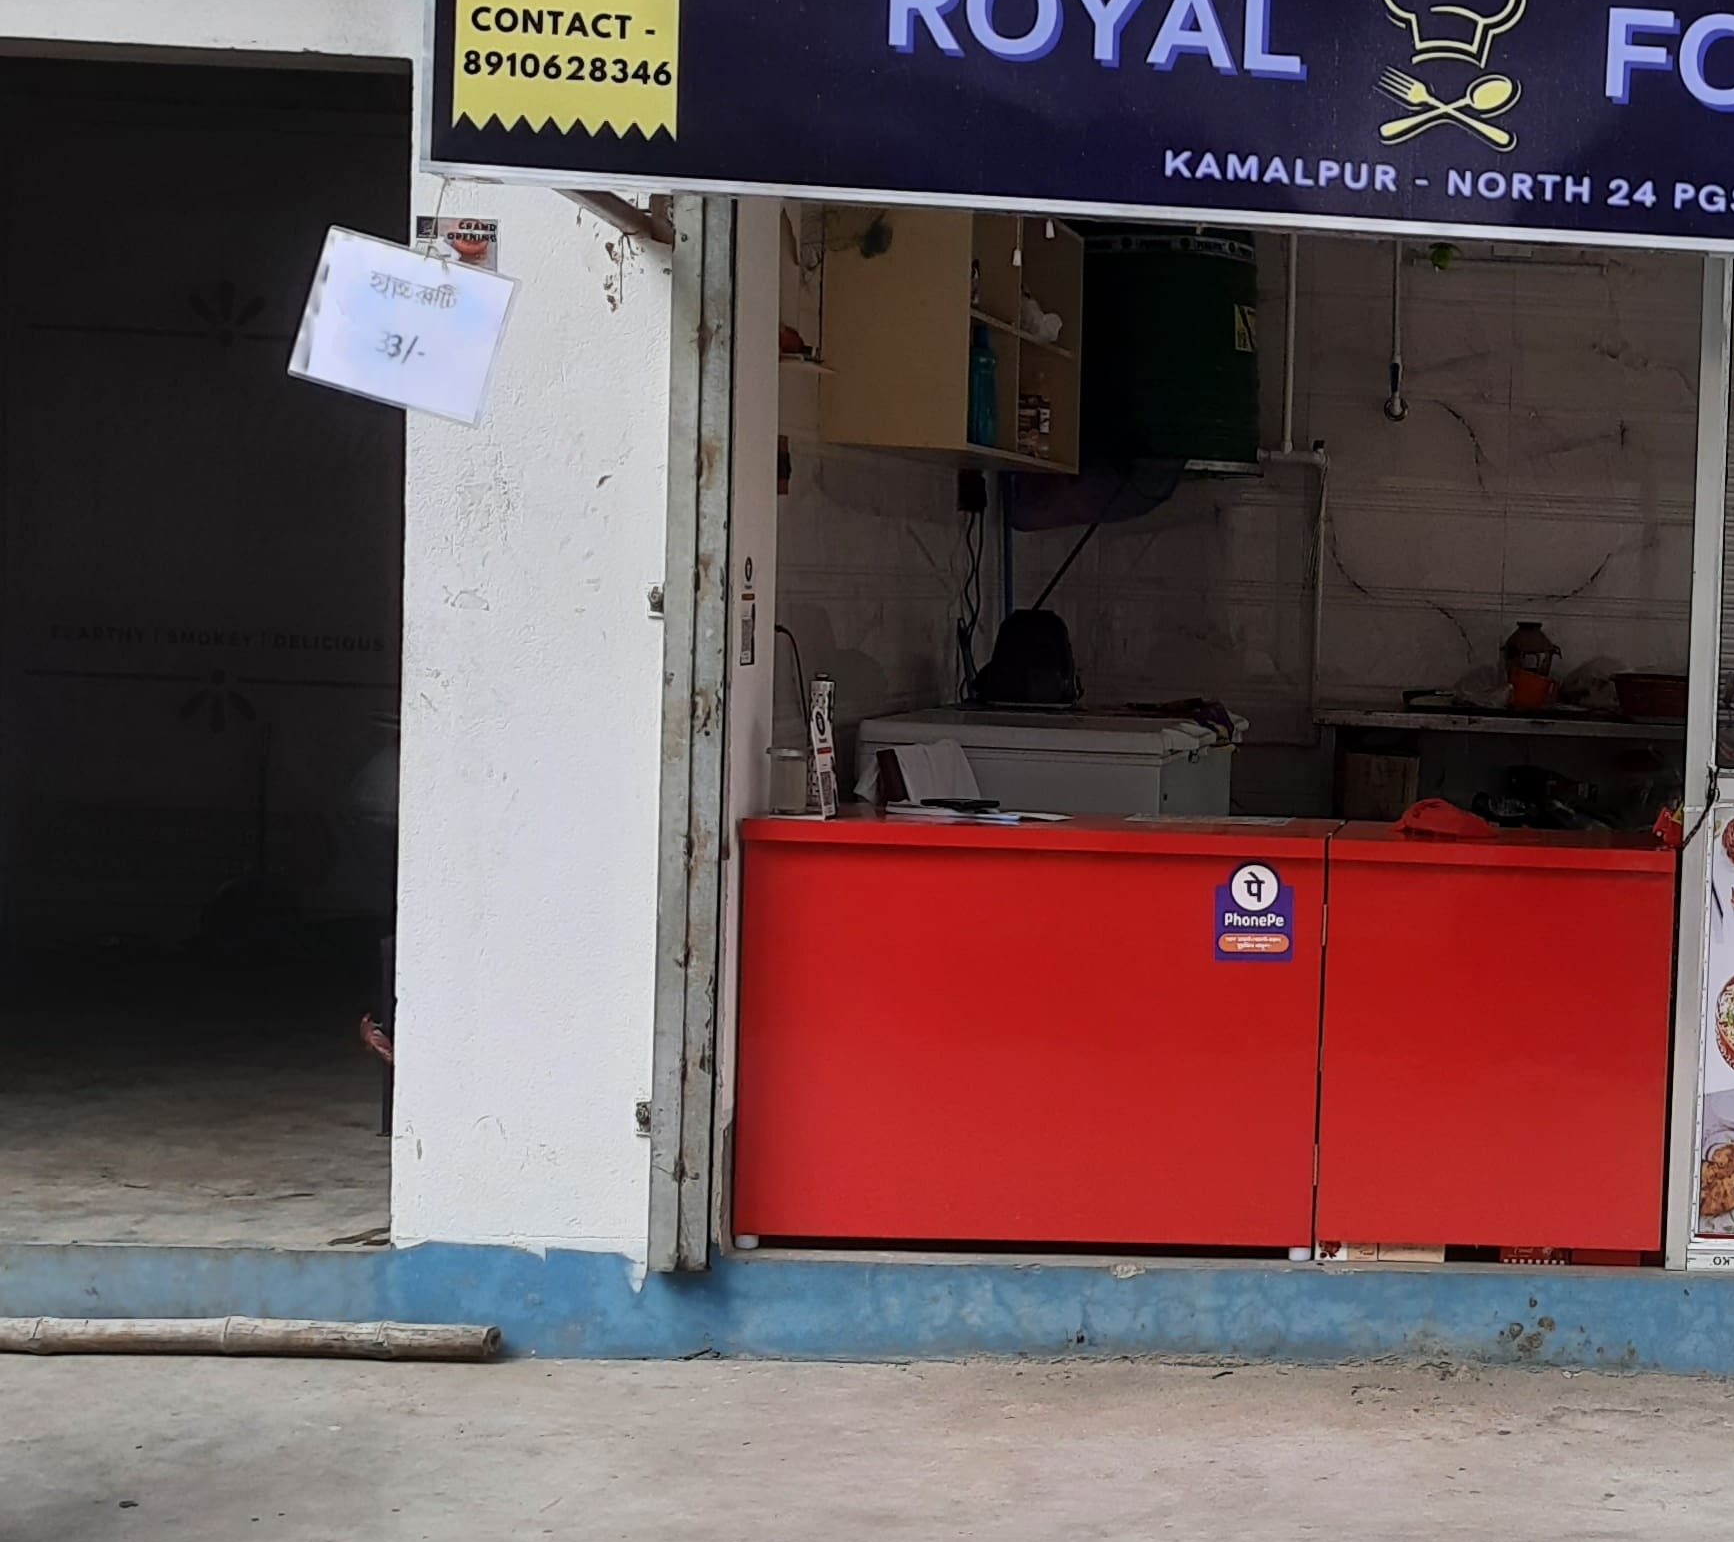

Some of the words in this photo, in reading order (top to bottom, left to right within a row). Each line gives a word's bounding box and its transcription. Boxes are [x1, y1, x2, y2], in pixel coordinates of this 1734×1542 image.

[471, 6, 632, 39] CONTACT
[463, 50, 672, 86] 8910628346
[1164, 150, 1398, 193] KAMALPUR
[1446, 170, 1591, 205] NORTH
[1607, 178, 1657, 208] 24
[459, 222, 497, 232] GRAND
[447, 232, 498, 243] OPENING
[273, 632, 385, 652] DELICIOUS
[1224, 912, 1285, 927] PhonePe
